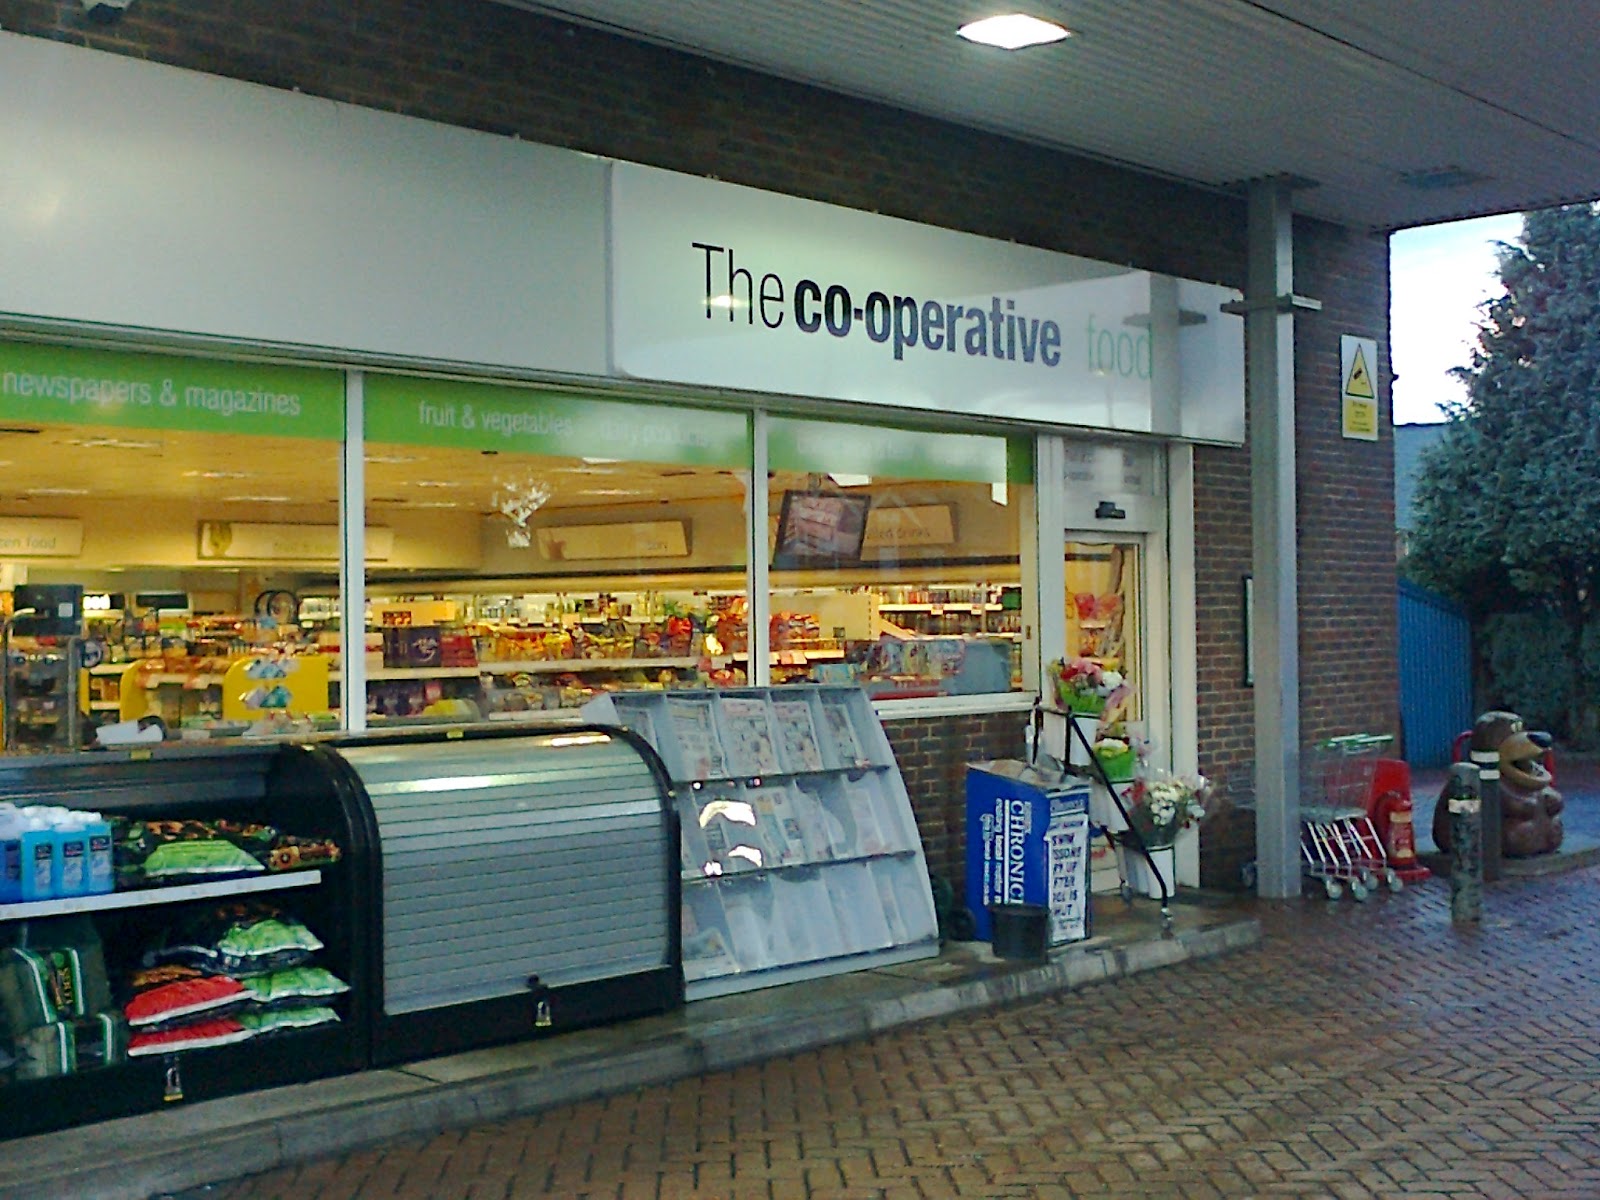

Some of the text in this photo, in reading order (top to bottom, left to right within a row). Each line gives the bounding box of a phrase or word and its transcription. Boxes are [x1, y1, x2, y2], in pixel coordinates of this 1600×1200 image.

[692, 242, 1154, 380] The co-operative food
[2, 370, 302, 417] newspapers & magazines
[418, 400, 456, 427] fruit
[461, 404, 476, 430] &
[481, 410, 574, 438] vegetables
